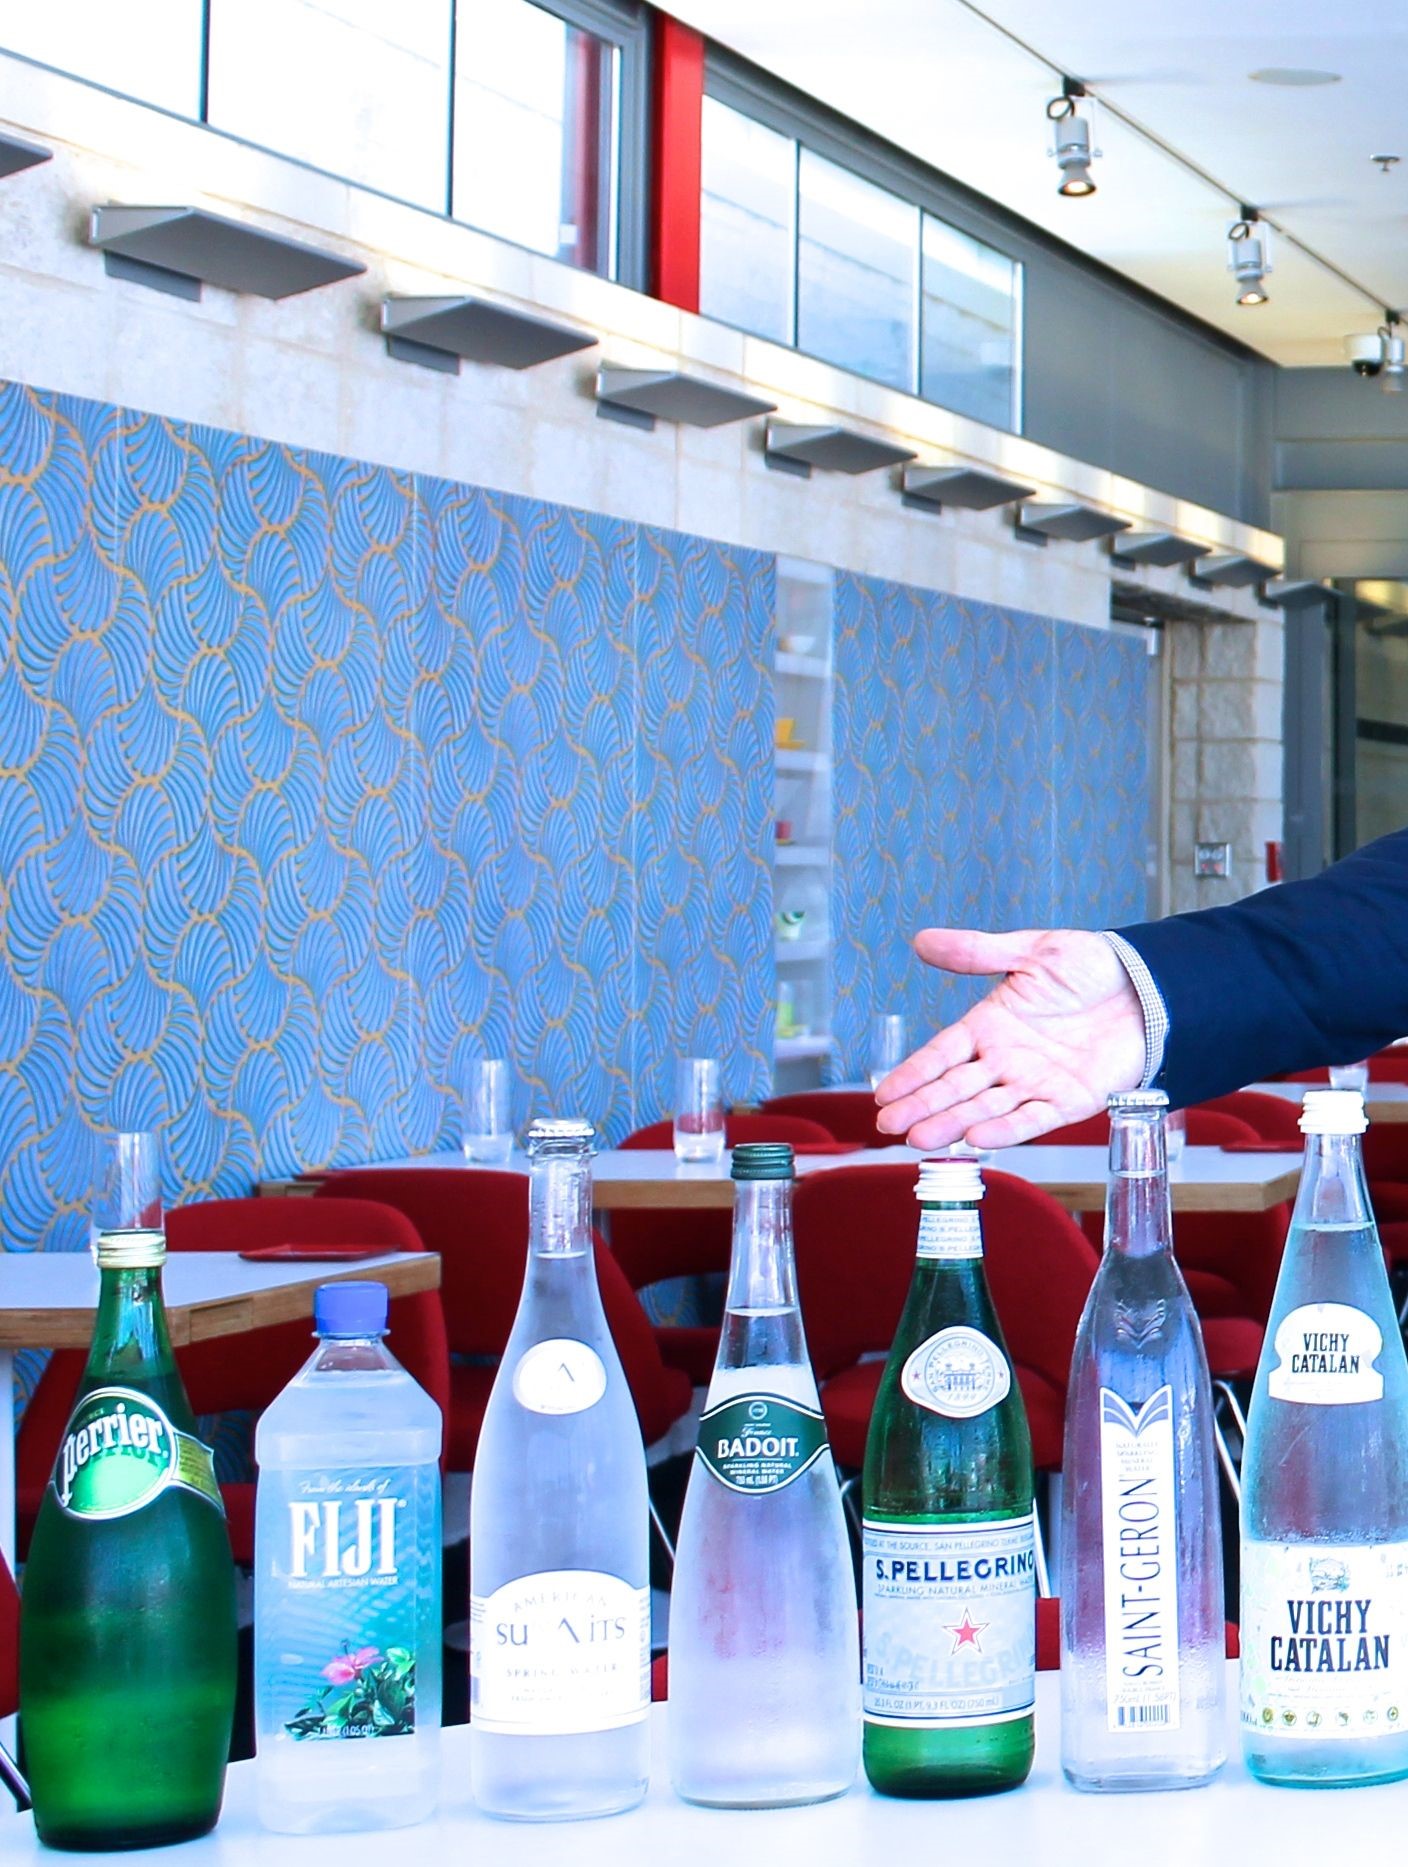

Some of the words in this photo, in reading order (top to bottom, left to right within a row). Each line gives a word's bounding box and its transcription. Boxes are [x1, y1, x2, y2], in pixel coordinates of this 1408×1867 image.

[1303, 1333, 1349, 1352] VICHY
[1292, 1354, 1360, 1373] CATALAN
[61, 1403, 163, 1507] perrier
[717, 1437, 796, 1458] BADOIT
[288, 1497, 398, 1577] FIJI
[876, 1550, 1034, 1582] S.PELLEGRINO
[1287, 1599, 1372, 1635] VICHY
[1271, 1634, 1391, 1673] CATALAN
